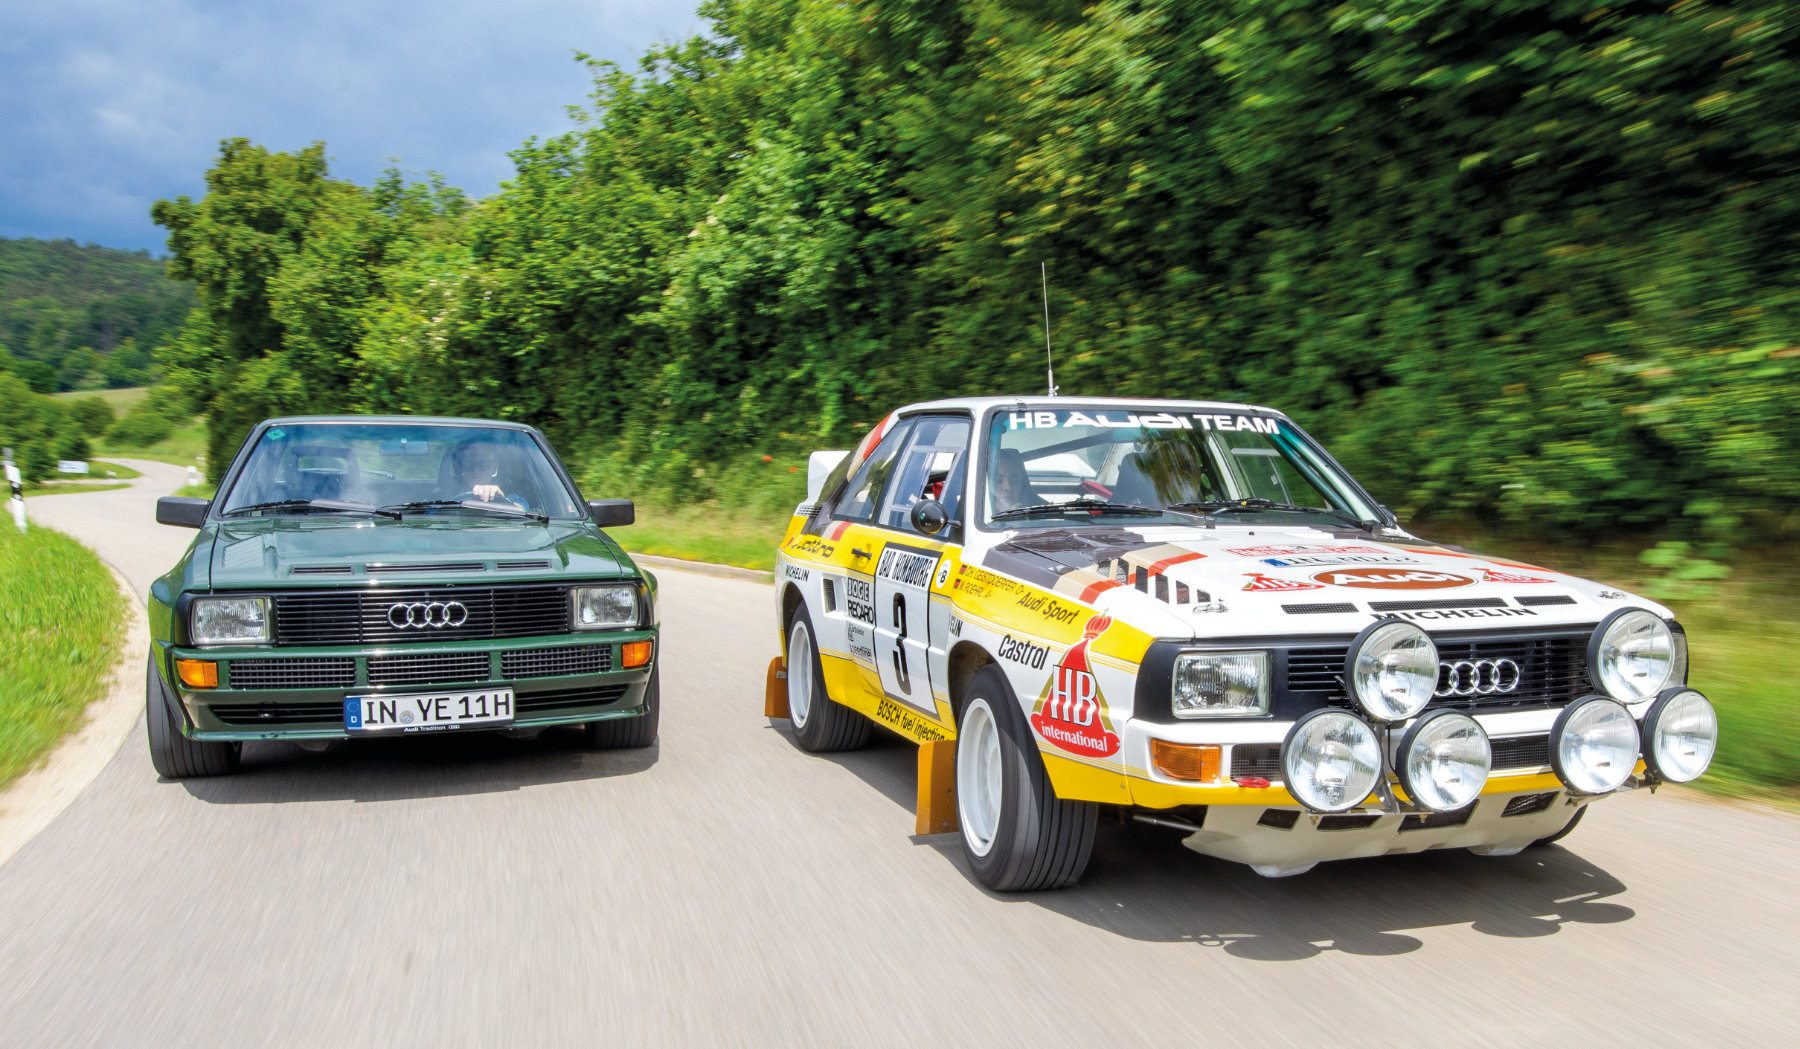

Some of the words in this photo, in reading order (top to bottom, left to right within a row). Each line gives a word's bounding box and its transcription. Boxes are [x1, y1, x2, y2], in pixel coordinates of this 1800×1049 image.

[1009, 412, 1057, 430] HB
[1192, 414, 1281, 435] TEAM
[785, 564, 810, 582] MICHELIN
[879, 550, 896, 578] BAD
[892, 553, 933, 588] HOMBOURG
[847, 577, 869, 602] BOGE
[848, 600, 874, 624] RECARO
[1016, 592, 1048, 612] Audi
[1043, 600, 1079, 625] Sport
[1370, 608, 1538, 621] MICHELIN
[893, 592, 911, 696] 3
[998, 634, 1050, 670] Castrol
[364, 700, 397, 725] IN
[417, 697, 452, 721] YE
[458, 693, 510, 719] 11H
[1050, 664, 1097, 727] HB
[350, 715, 358, 724] D
[877, 700, 902, 726] BOSCH
[901, 713, 916, 732] fuel
[1041, 721, 1108, 752] international
